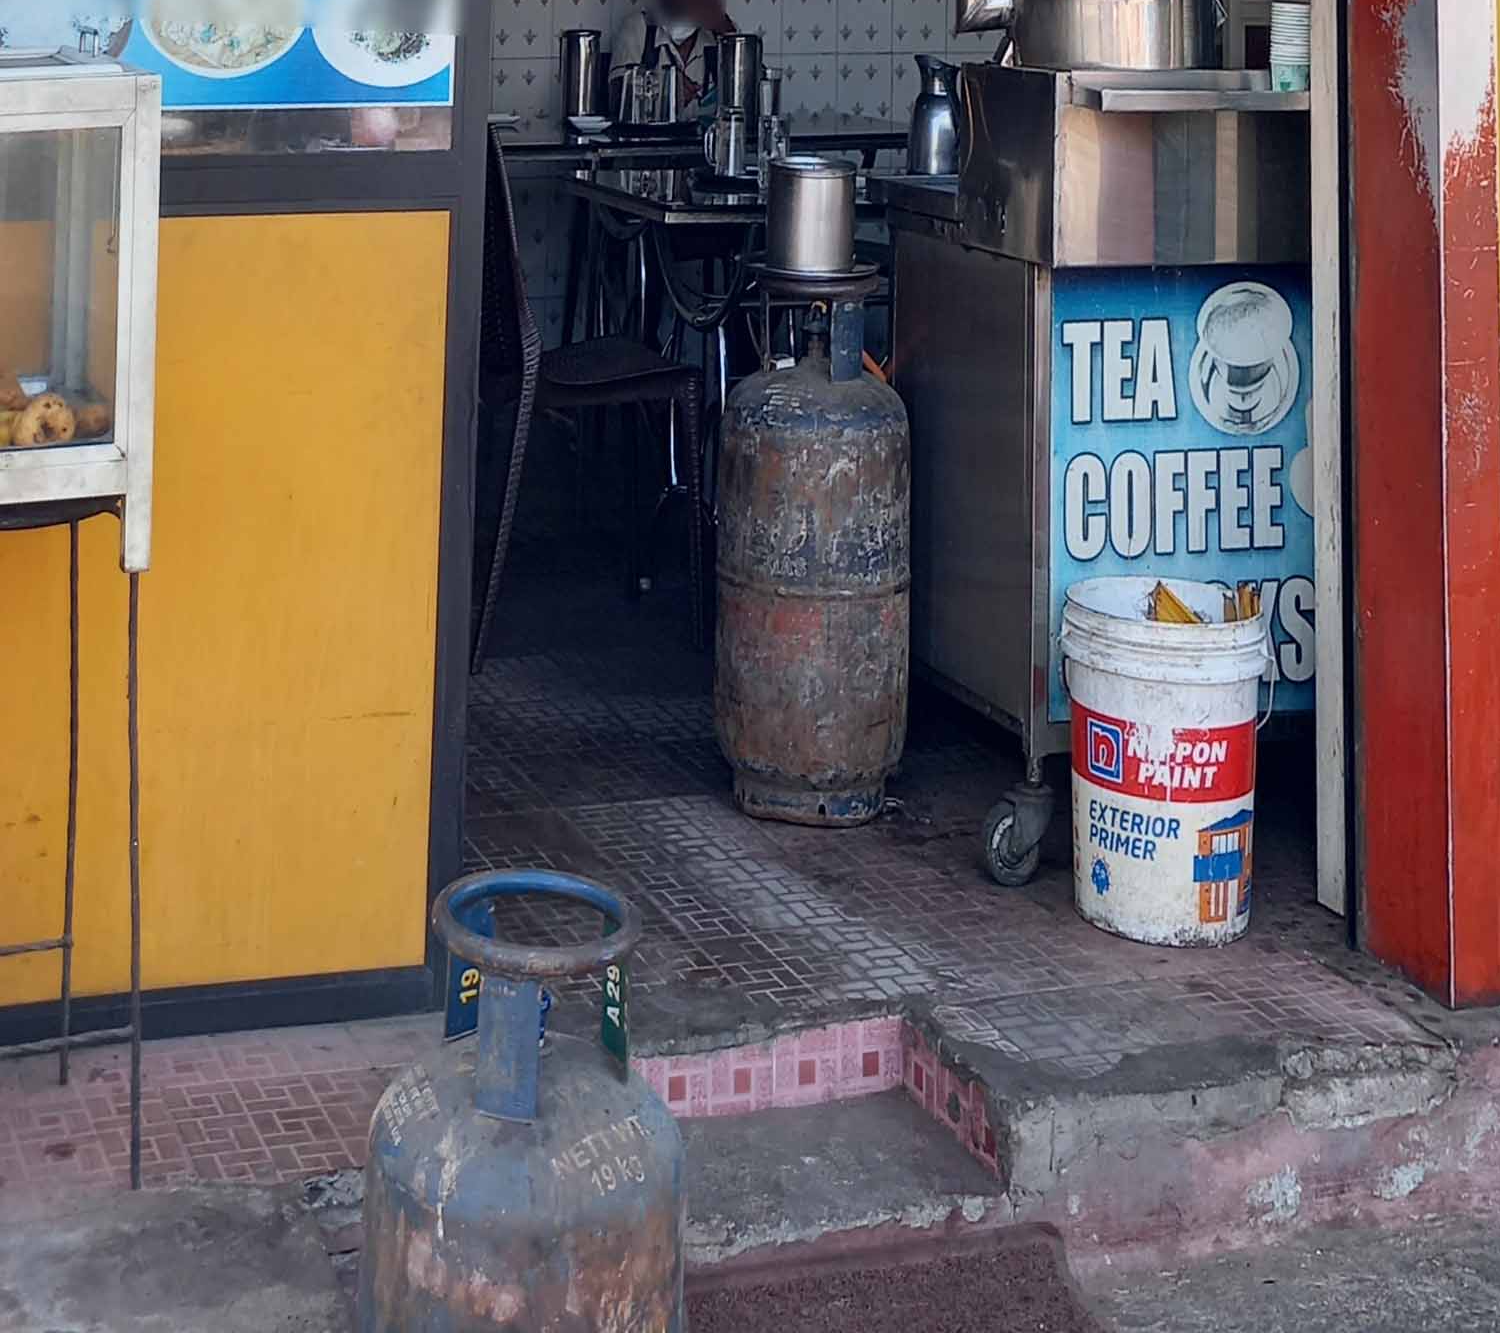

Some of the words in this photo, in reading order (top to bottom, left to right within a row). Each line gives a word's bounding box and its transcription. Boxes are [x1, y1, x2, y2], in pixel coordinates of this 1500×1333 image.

[1061, 317, 1177, 423] TEA
[1064, 447, 1286, 561] COFFEE
[1136, 761, 1219, 790] PAINT
[1089, 798, 1181, 841] EXTERIOR
[1089, 823, 1158, 862] PRIMER
